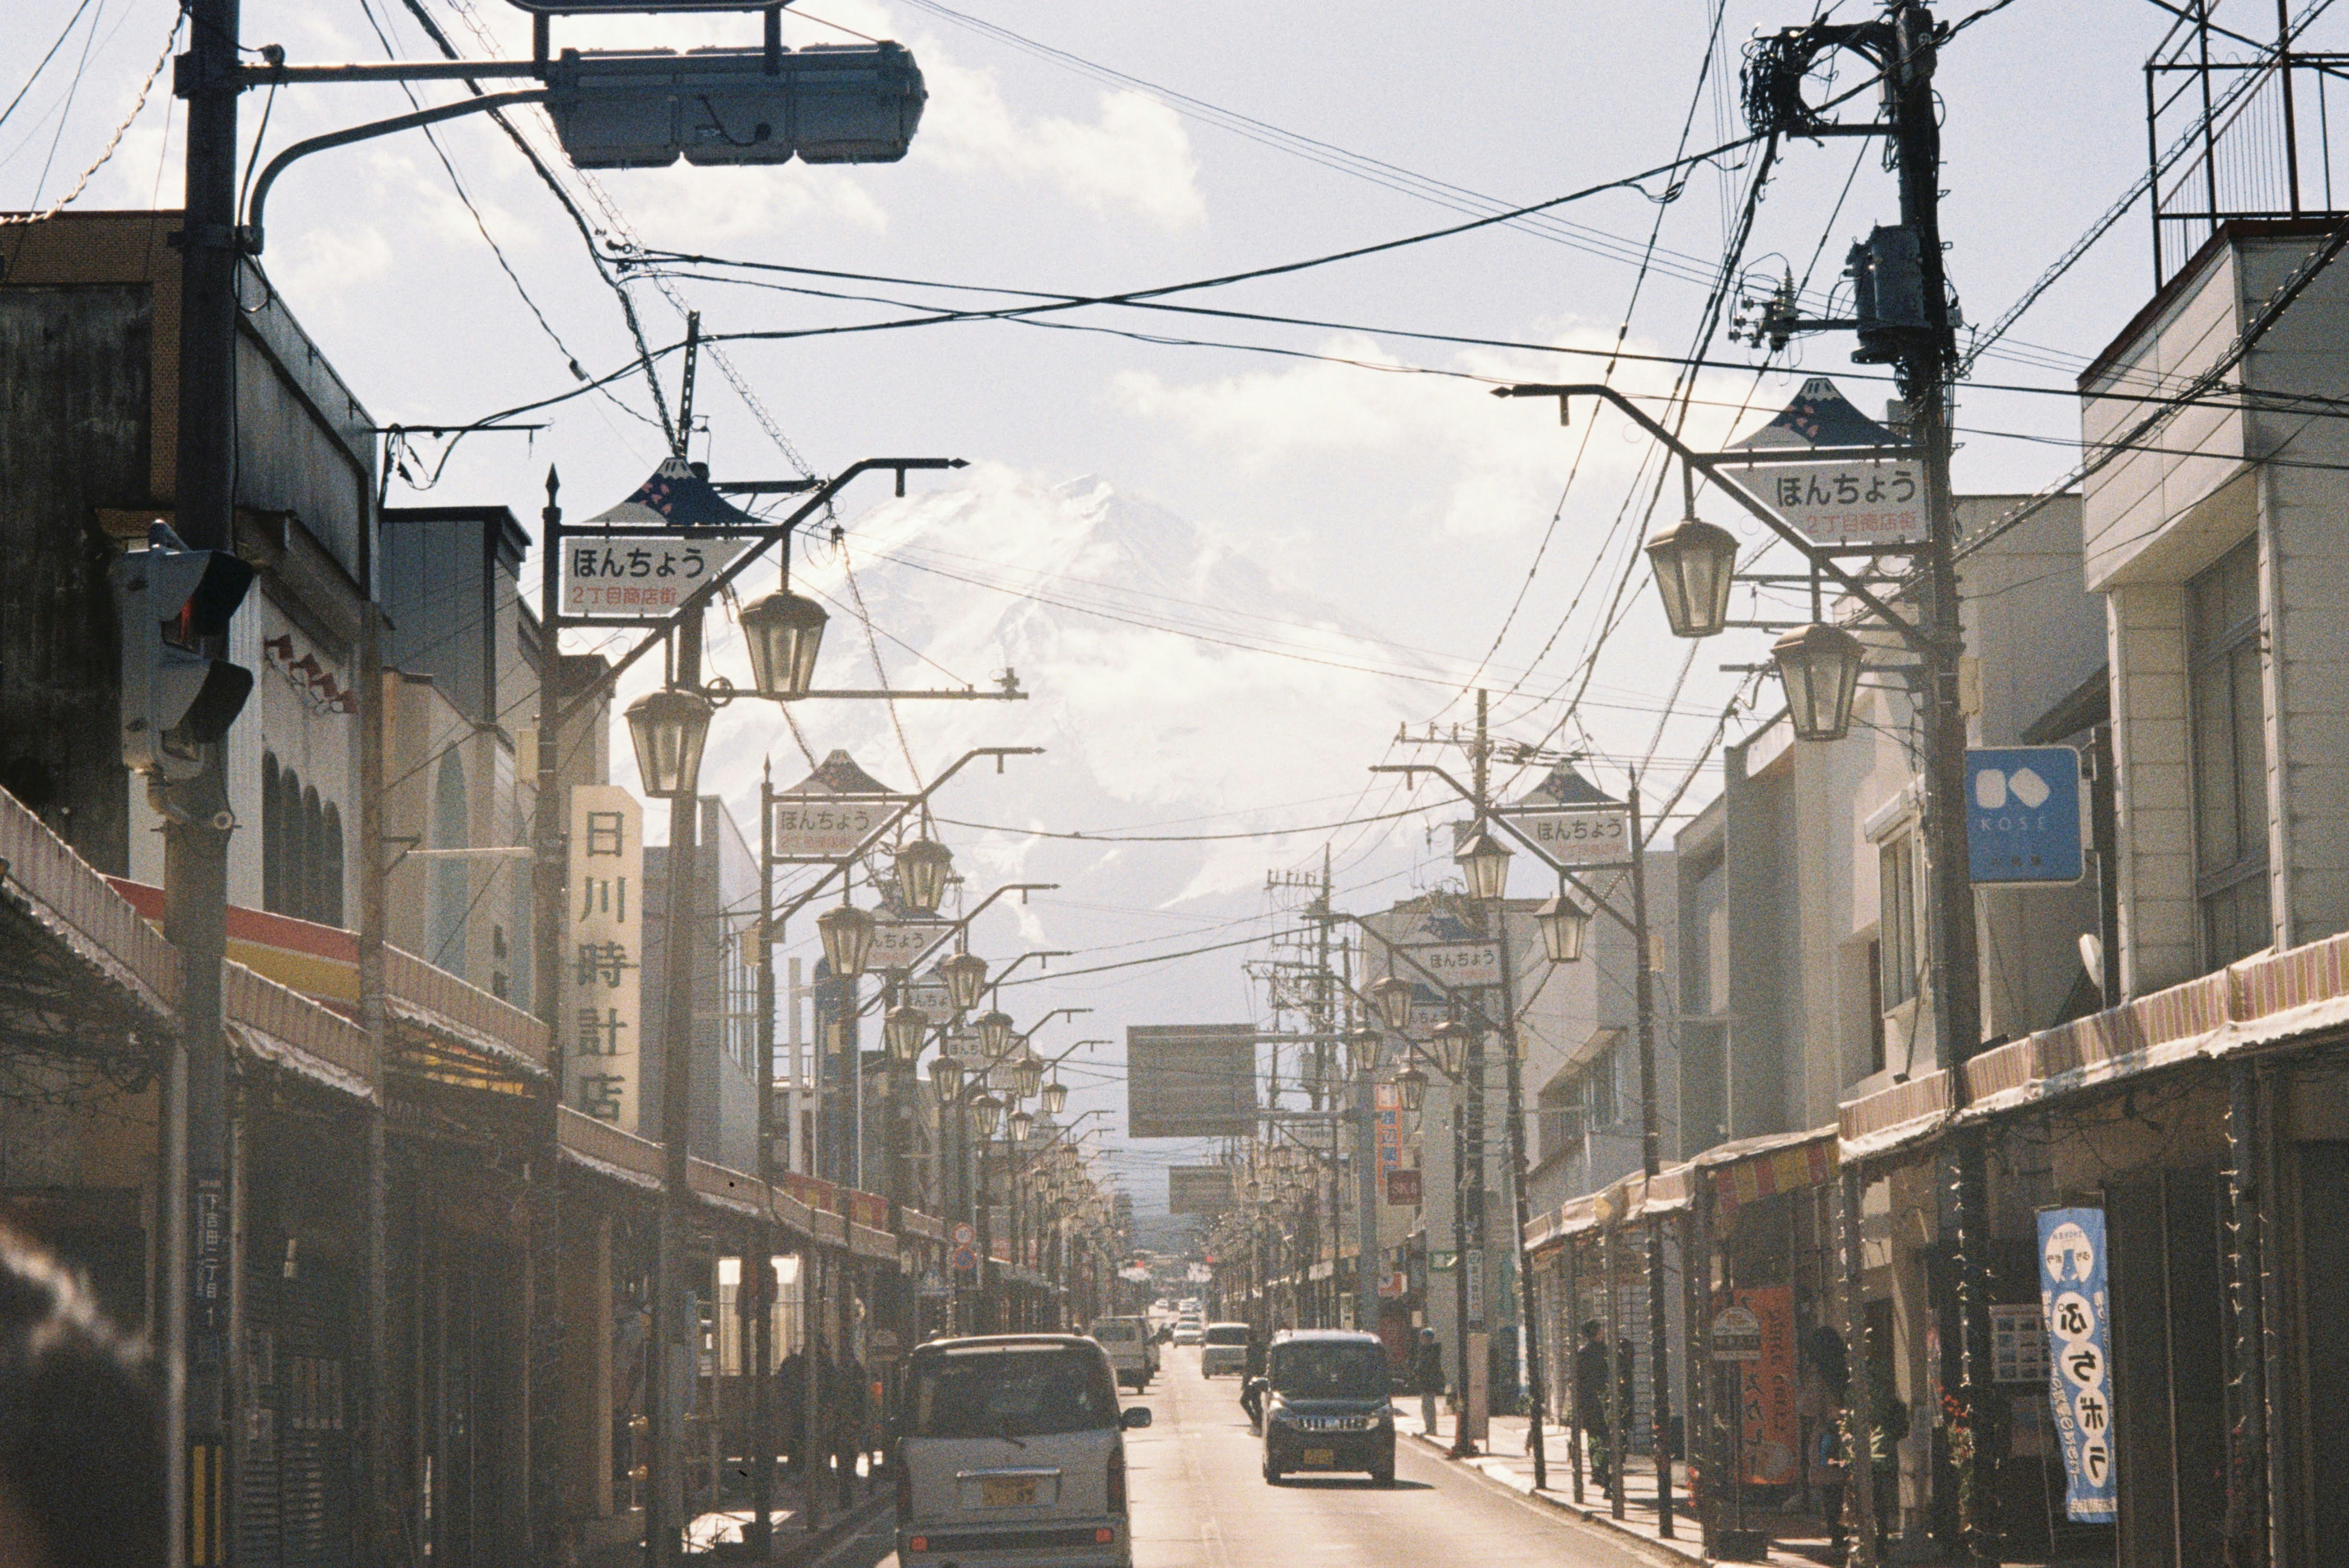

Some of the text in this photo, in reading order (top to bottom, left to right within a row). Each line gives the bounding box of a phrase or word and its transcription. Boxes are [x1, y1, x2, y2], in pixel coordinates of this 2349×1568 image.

[1777, 471, 1915, 507] ほんちょう
[574, 548, 704, 577] ほんちょう
[781, 810, 869, 831] ほんちょう
[1537, 817, 1623, 841] ほんちょう
[578, 811, 628, 1122] 日川時計店
[1431, 950, 1494, 968] ほんちょう
